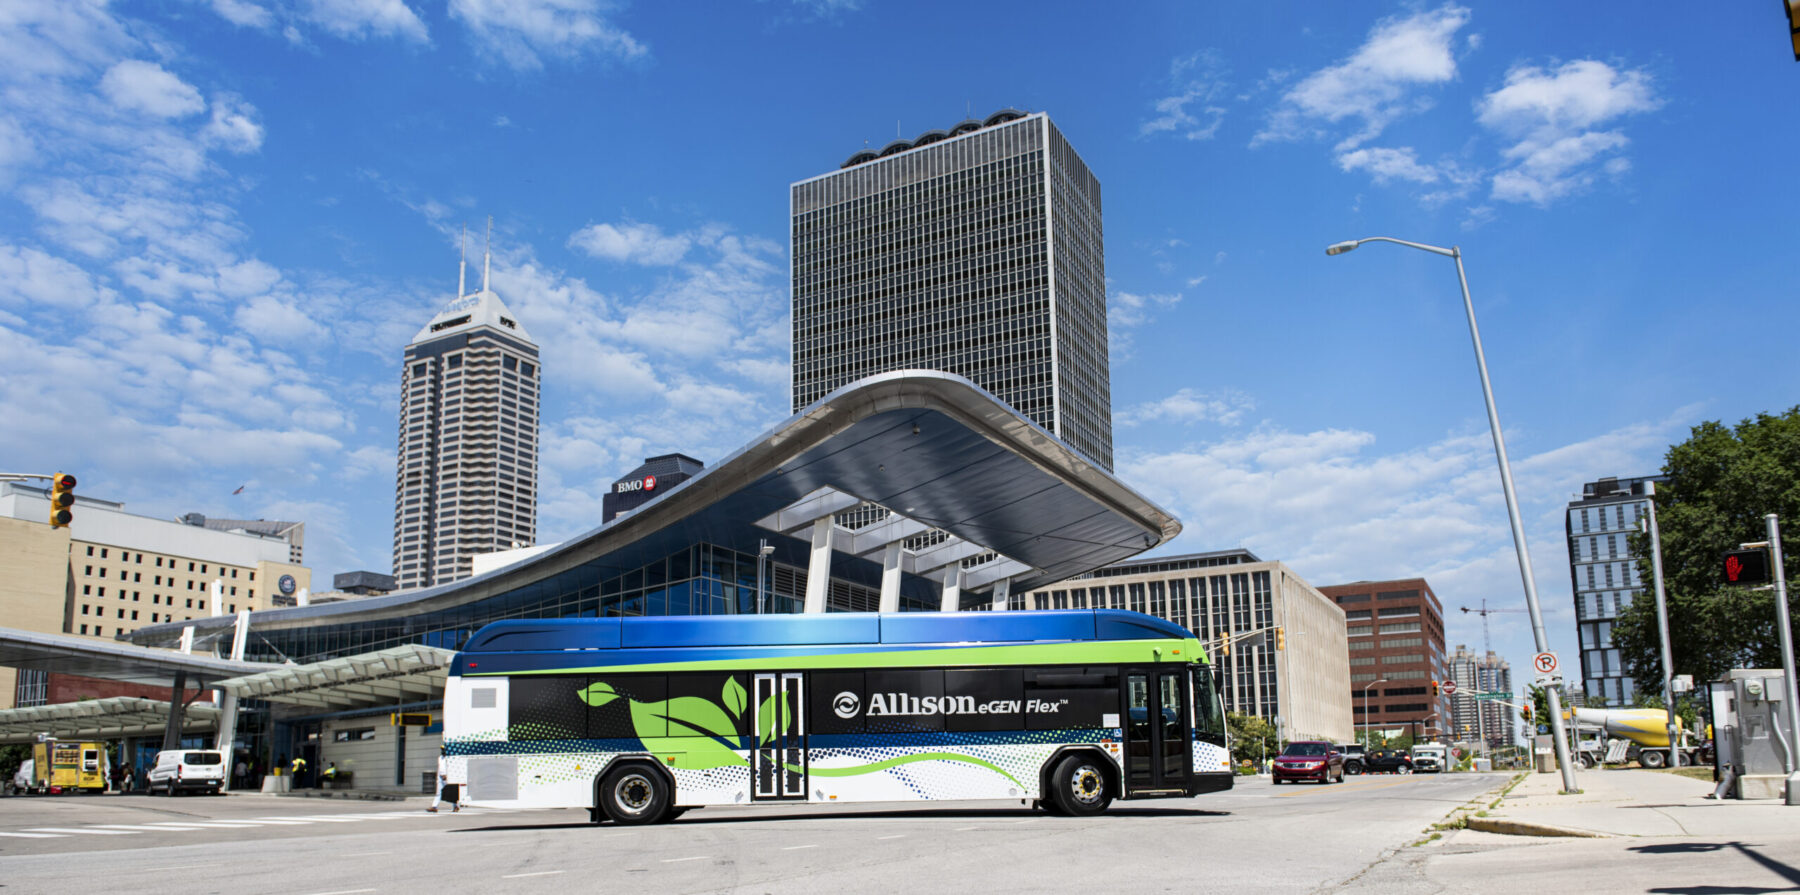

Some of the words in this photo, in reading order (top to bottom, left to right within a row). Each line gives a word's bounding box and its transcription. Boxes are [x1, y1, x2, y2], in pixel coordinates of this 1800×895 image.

[618, 480, 643, 493] BMO
[1541, 657, 1552, 669] P
[866, 692, 978, 716] Allison
[978, 700, 1021, 714] eGEN
